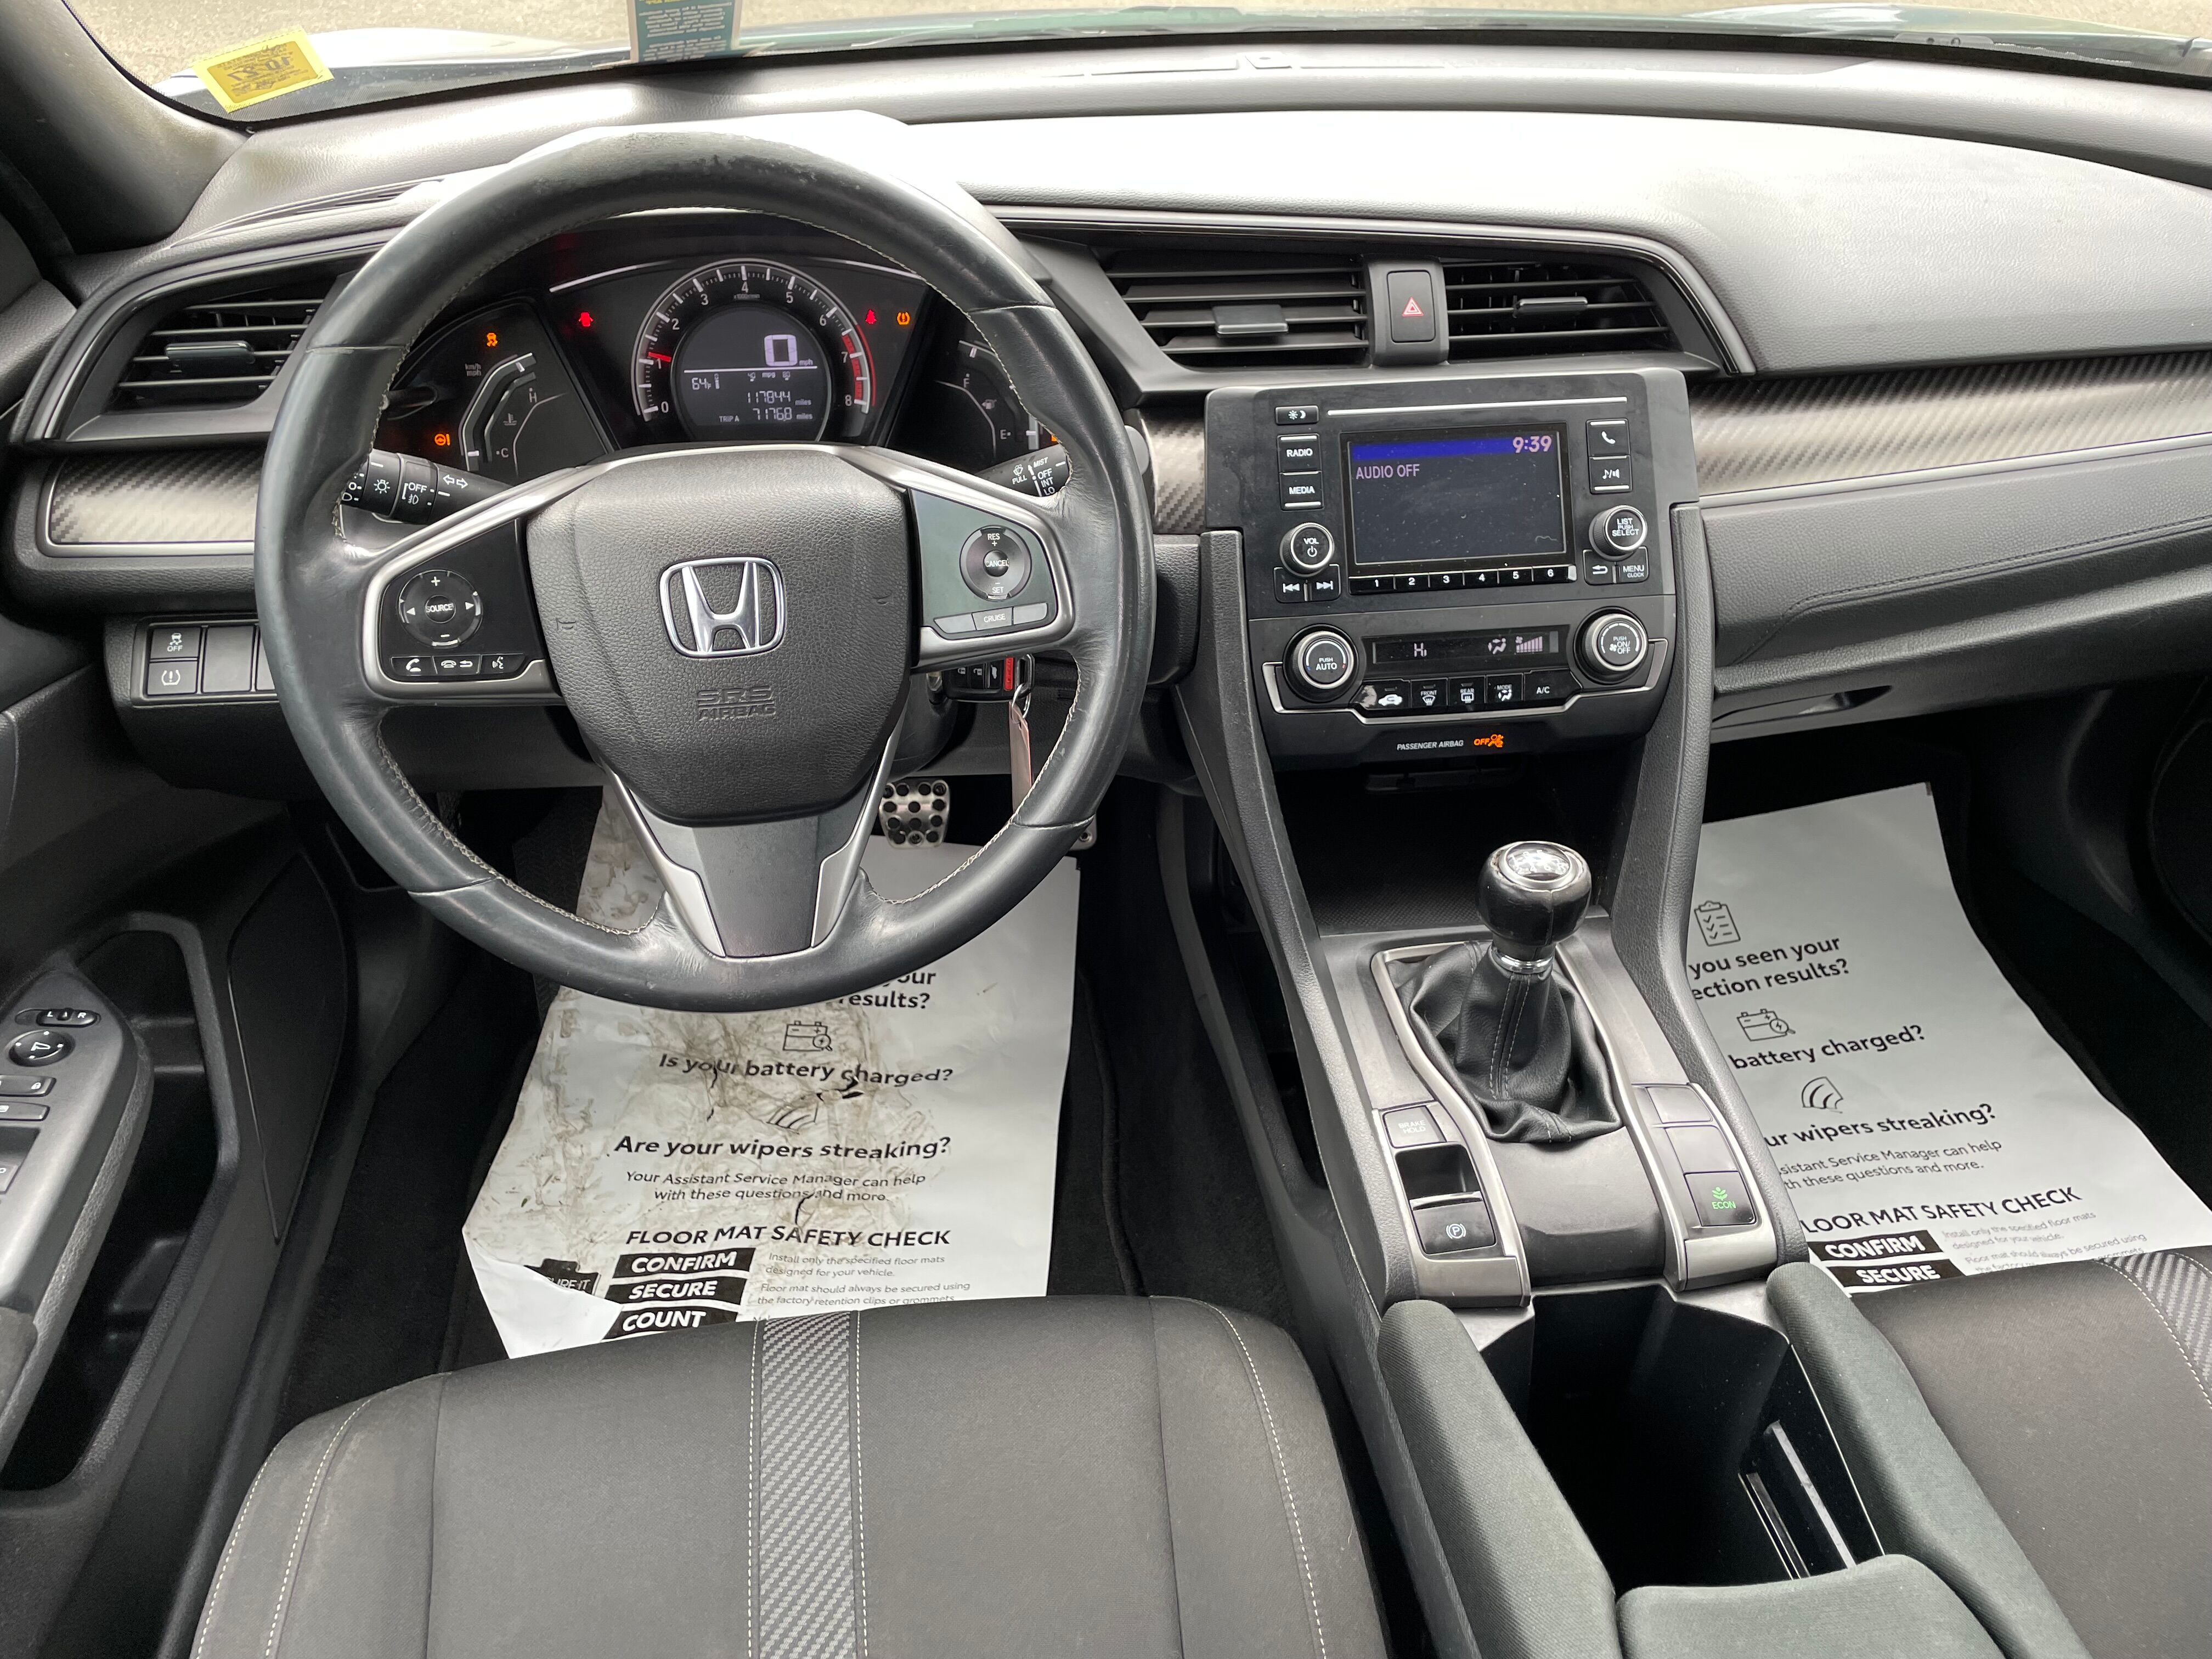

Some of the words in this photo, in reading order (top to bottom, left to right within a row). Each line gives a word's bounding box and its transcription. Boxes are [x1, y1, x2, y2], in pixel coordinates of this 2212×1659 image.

[741, 281, 748, 293] 4
[700, 294, 709, 306] 3
[786, 292, 794, 303] 5
[672, 318, 680, 330] 2
[819, 314, 827, 326] 6
[764, 334, 798, 367] 0
[799, 358, 814, 368] mph
[841, 351, 848, 363] 7
[963, 378, 970, 387] F
[529, 392, 537, 403] H
[747, 390, 791, 404] 117844
[845, 394, 853, 407] 8
[661, 401, 669, 413] 0
[1000, 430, 1007, 439] E
[1513, 435, 1553, 454] 9:39
[501, 448, 509, 458] C
[1286, 448, 1313, 458] RADIO
[1033, 456, 1049, 468] MIST
[1037, 468, 1052, 480] OFF
[1355, 465, 1394, 480] AUDIO
[1397, 464, 1420, 478] OFF
[1012, 475, 1028, 484] PULL
[1040, 477, 1053, 488] INT
[408, 482, 427, 493] OFF
[1043, 486, 1056, 495] LO
[1289, 486, 1316, 495] MEDIA
[987, 533, 1001, 541] RES
[1612, 528, 1639, 537] SELECT
[985, 559, 1009, 568] CANCEL
[1623, 565, 1645, 573] MENU
[1374, 579, 1379, 588] 1
[1408, 577, 1415, 586] 2
[1442, 575, 1450, 584] 3
[1478, 573, 1486, 582] 4
[1513, 571, 1520, 579] 5
[1547, 569, 1554, 577] 6
[991, 586, 1005, 594] SET
[425, 603, 454, 613] SOURCE
[983, 613, 1006, 623] CRUISE
[1316, 663, 1338, 671] AUTO
[696, 685, 775, 706] SRS
[1420, 689, 1437, 697] FRONT
[1536, 686, 1550, 695] A/C
[698, 704, 776, 721] AIRBAG
[1397, 741, 1437, 751] PASSENGER
[1438, 740, 1464, 748] AIRBAG
[1474, 738, 1489, 746] OFF
[1689, 958, 1731, 980] you
[1735, 946, 1788, 968] seen
[1790, 937, 1841, 962] your
[1764, 957, 1850, 988] results?
[839, 990, 930, 1009] esults?
[1728, 1047, 1816, 1070] battery
[1821, 1024, 1926, 1057] charged?
[658, 1053, 679, 1068] Is
[682, 1058, 738, 1075] your
[744, 1059, 834, 1081] battery
[840, 1063, 953, 1088] charged?
[1397, 1119, 1426, 1129] BRAKE
[1792, 1120, 1874, 1143] wipers
[1877, 1102, 1996, 1133] streaking?
[1402, 1126, 1426, 1135] HOLD
[613, 1135, 660, 1153] Are
[663, 1138, 724, 1156] your
[729, 1139, 813, 1160] wipers
[820, 1136, 951, 1160] streaking?
[1829, 1152, 1881, 1168] Service
[1881, 1147, 1940, 1164] Manager
[1943, 1144, 1970, 1158] can
[1971, 1139, 2002, 1155] help
[1802, 1172, 1844, 1187] these
[1847, 1163, 1914, 1183] questions
[1916, 1160, 1942, 1174] and
[1944, 1159, 1985, 1172] more.
[627, 1171, 661, 1182] Your
[662, 1172, 730, 1185] Assistant
[734, 1173, 788, 1186] Service
[792, 1175, 859, 1188] Manager
[862, 1177, 889, 1187] can
[894, 1173, 927, 1187] help
[654, 1188, 686, 1201] with
[690, 1187, 731, 1200] these
[735, 1188, 810, 1201] questions
[814, 1189, 844, 1201] and
[1711, 1200, 1736, 1210] ECON
[1869, 1205, 1925, 1226] MAT
[1926, 1199, 2006, 1220] SAFETY
[2000, 1186, 2084, 1215] CHECK
[2047, 1217, 2071, 1228] floor
[2073, 1212, 2097, 1222] mats
[625, 1229, 709, 1246] FLOOR
[713, 1226, 768, 1242] MAT
[770, 1225, 864, 1247] SAFETY
[867, 1229, 951, 1247] CHECK
[1824, 1234, 1926, 1260] CONFIRM
[2067, 1247, 2084, 1255] be
[2083, 1237, 2120, 1252] secured
[2120, 1234, 2148, 1244] using
[630, 1251, 738, 1273] CONFIRM
[768, 1252, 800, 1263] Install
[802, 1255, 823, 1266] only
[827, 1257, 843, 1265] the
[846, 1255, 892, 1266] specified
[894, 1257, 918, 1266] floor
[765, 1265, 814, 1277] designed
[816, 1268, 831, 1277] for
[832, 1269, 855, 1279] your
[857, 1268, 895, 1277] vehicle.
[1860, 1262, 1942, 1284] SECURE
[628, 1280, 718, 1301] SECURE
[760, 1283, 786, 1293] Floor
[811, 1284, 847, 1294] should
[848, 1284, 882, 1294] always
[884, 1285, 898, 1293] be
[900, 1283, 941, 1293] secured
[943, 1282, 971, 1291] using
[757, 1296, 775, 1305] the
[776, 1295, 812, 1306] factory
[814, 1296, 861, 1306] retention
[862, 1296, 887, 1306] clips
[622, 1310, 707, 1332] COUNT
